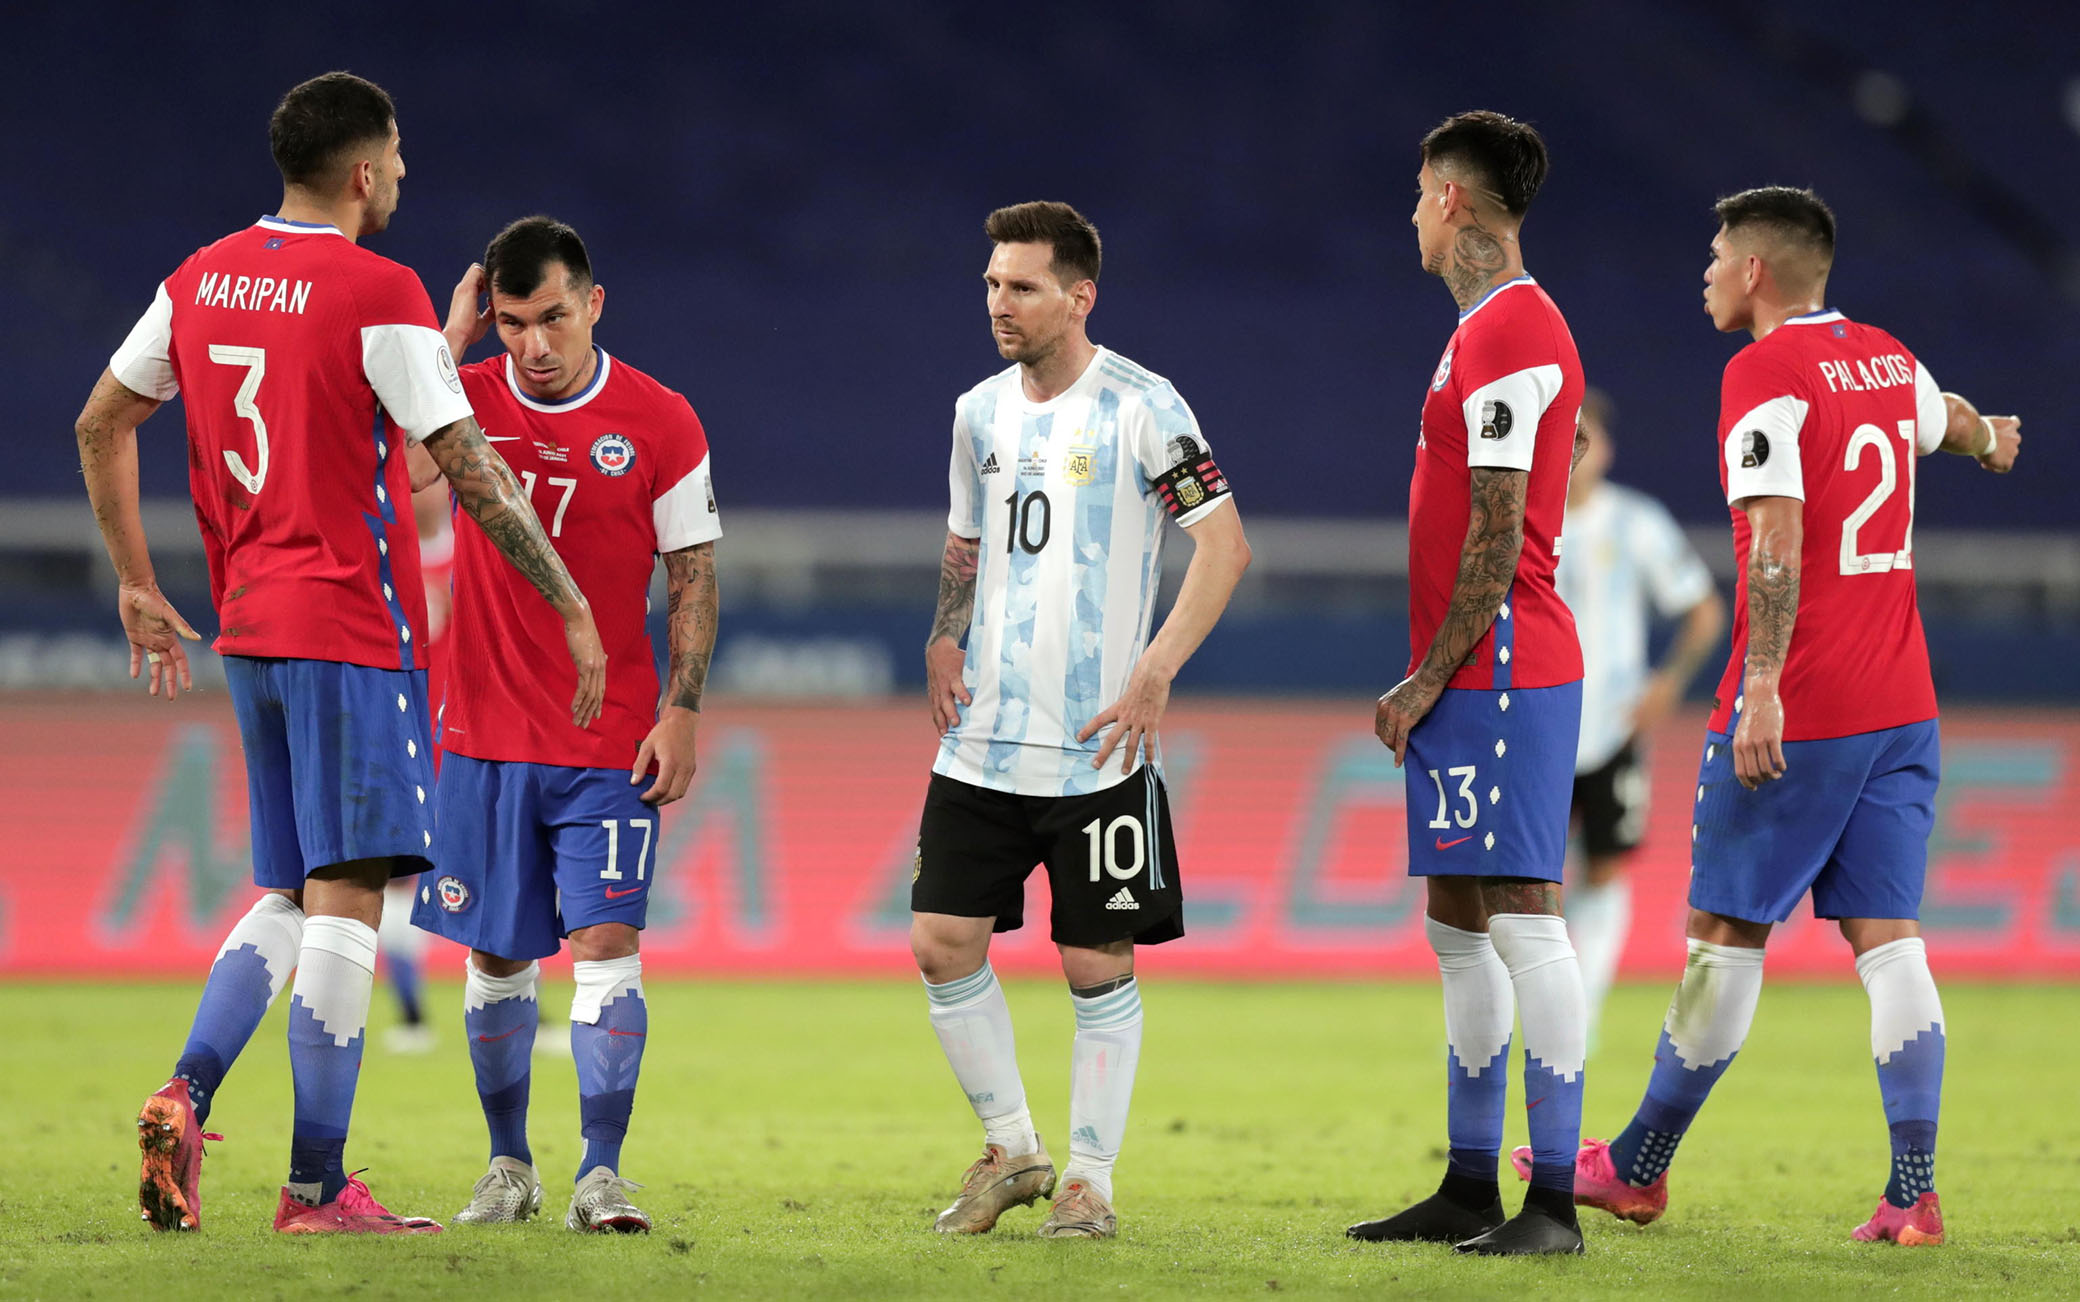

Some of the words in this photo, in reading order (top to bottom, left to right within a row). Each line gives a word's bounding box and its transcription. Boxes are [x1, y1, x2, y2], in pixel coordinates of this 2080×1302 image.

[195, 271, 313, 315] MARIPAN
[1818, 353, 1914, 393] PALACIOS
[208, 343, 269, 495] 3
[980, 465, 1001, 476] adidas
[1069, 455, 1089, 475] AFA
[520, 470, 577, 538] 17
[1005, 490, 1051, 556] 10
[1839, 419, 1916, 576] 21
[1428, 765, 1478, 829] 13
[600, 818, 652, 881] 17
[1081, 814, 1146, 883] 10
[1105, 901, 1141, 911] adidas
